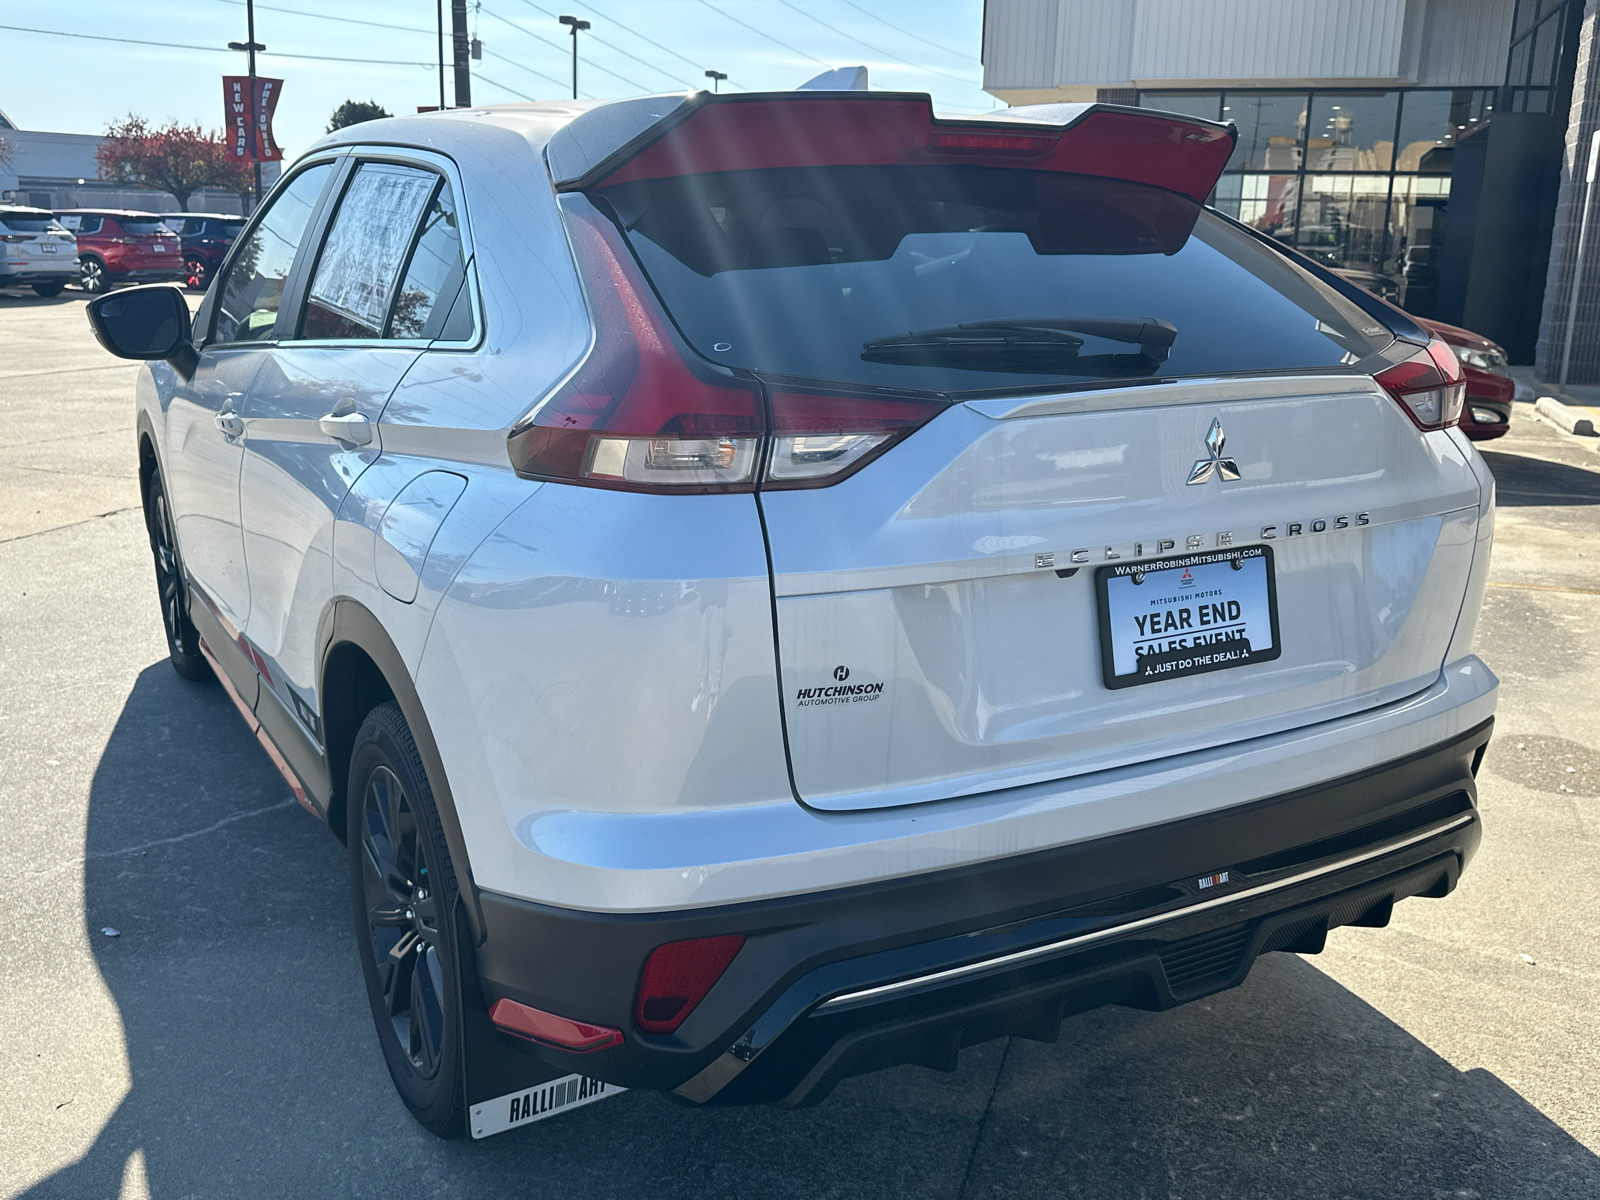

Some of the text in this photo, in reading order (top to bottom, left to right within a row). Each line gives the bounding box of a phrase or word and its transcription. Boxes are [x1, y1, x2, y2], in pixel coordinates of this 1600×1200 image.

[232, 82, 246, 157] NEW CARS
[259, 82, 273, 157] PRE-OWNED
[1035, 511, 1370, 569] ECLIPSE CROSS
[1150, 588, 1223, 607] MITSUBISHI MOTORS
[1133, 599, 1241, 637] YEAR END
[1154, 649, 1240, 674] JUST DO THE DEAL!
[796, 682, 884, 699] HUTCHINSON
[797, 694, 880, 707] AUTOMOTIVE GROUP
